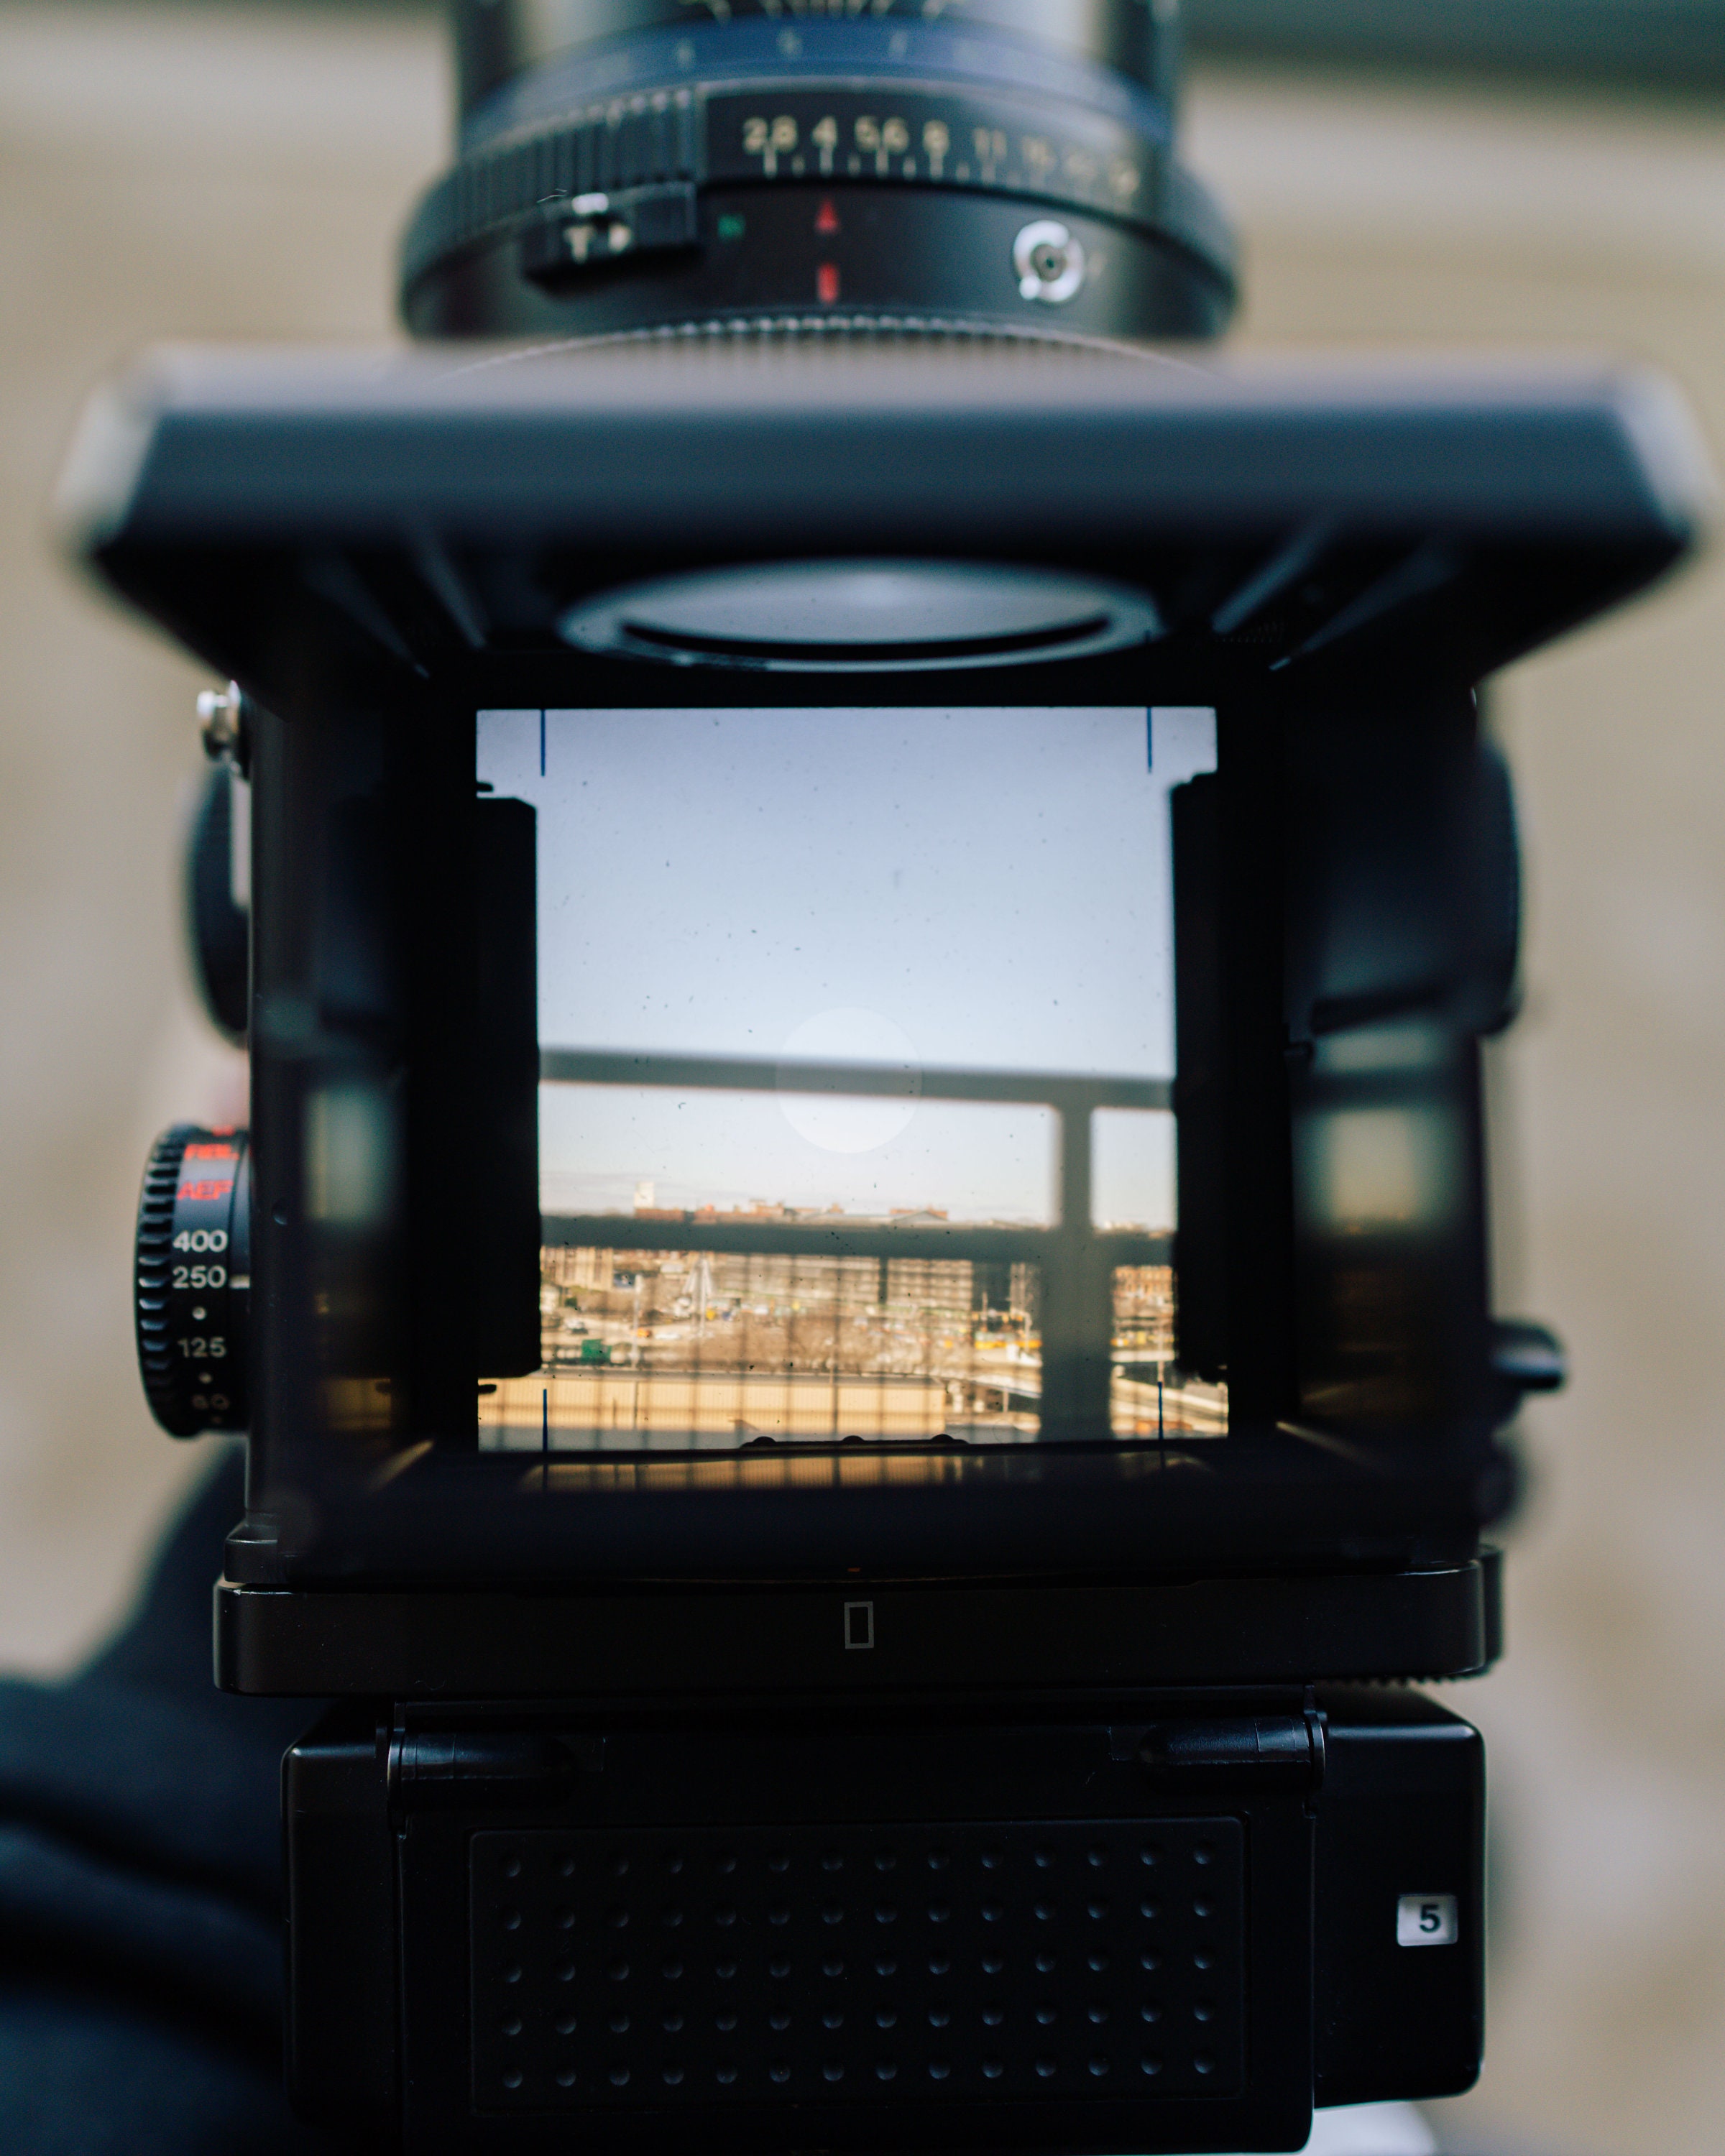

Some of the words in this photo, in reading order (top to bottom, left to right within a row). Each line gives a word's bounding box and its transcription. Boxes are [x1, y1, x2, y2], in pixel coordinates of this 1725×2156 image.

[812, 115, 838, 148] 4
[172, 1229, 228, 1253] 400
[172, 1266, 227, 1289] 250
[177, 1337, 227, 1358] 125
[1419, 1904, 1442, 1934] 5
